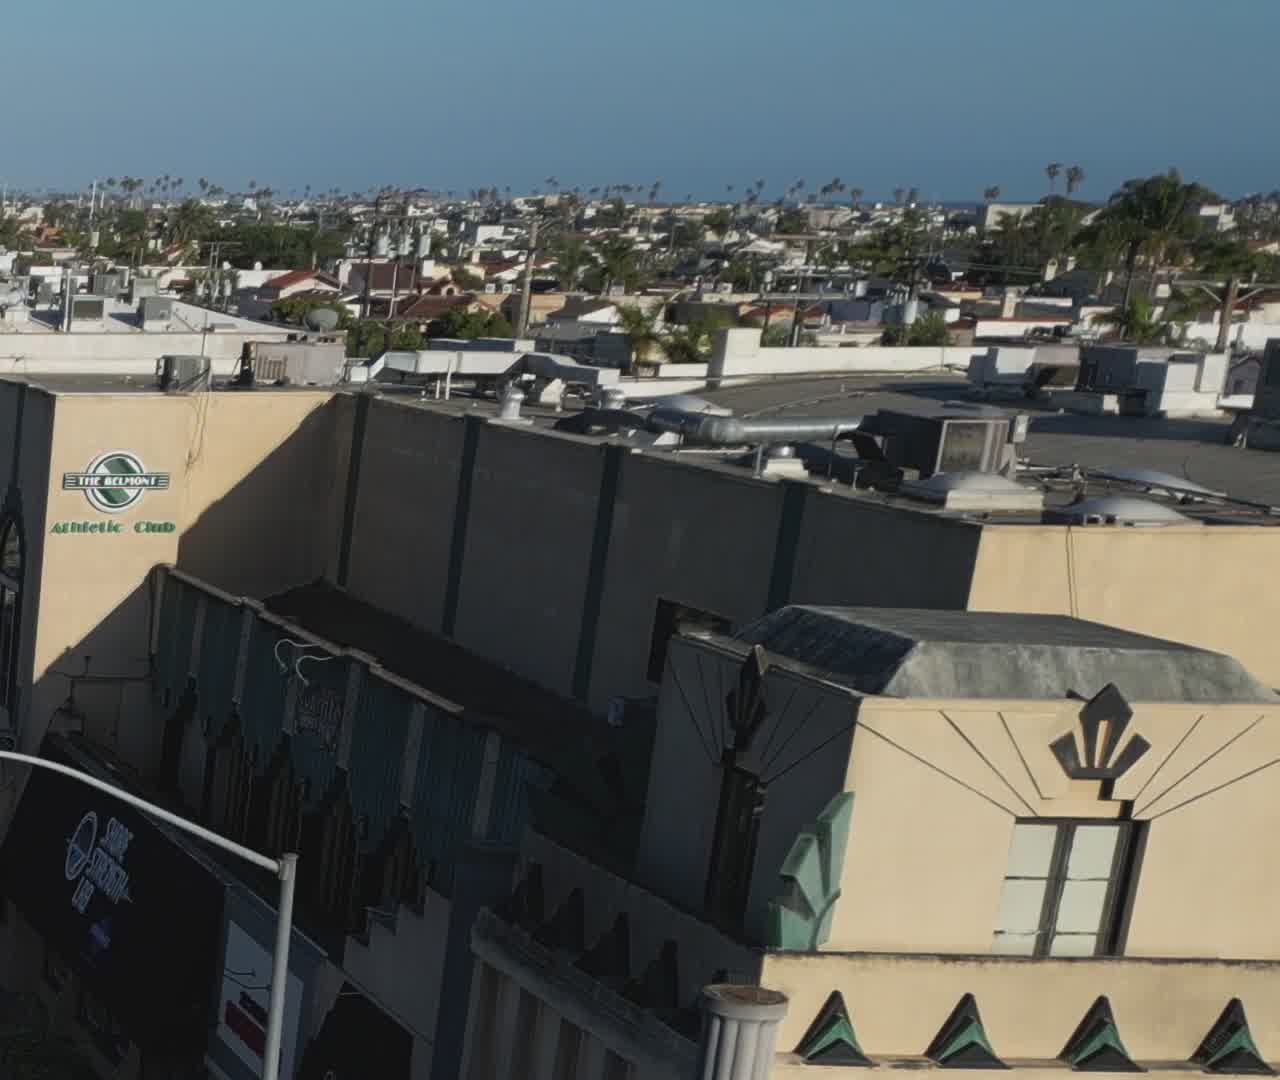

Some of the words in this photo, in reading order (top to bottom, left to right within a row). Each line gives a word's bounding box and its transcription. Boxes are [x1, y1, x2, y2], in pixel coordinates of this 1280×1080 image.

[78, 476, 101, 486] THE
[104, 476, 156, 486] BELMONT
[49, 519, 123, 535] Athletic
[133, 519, 177, 535] Club
